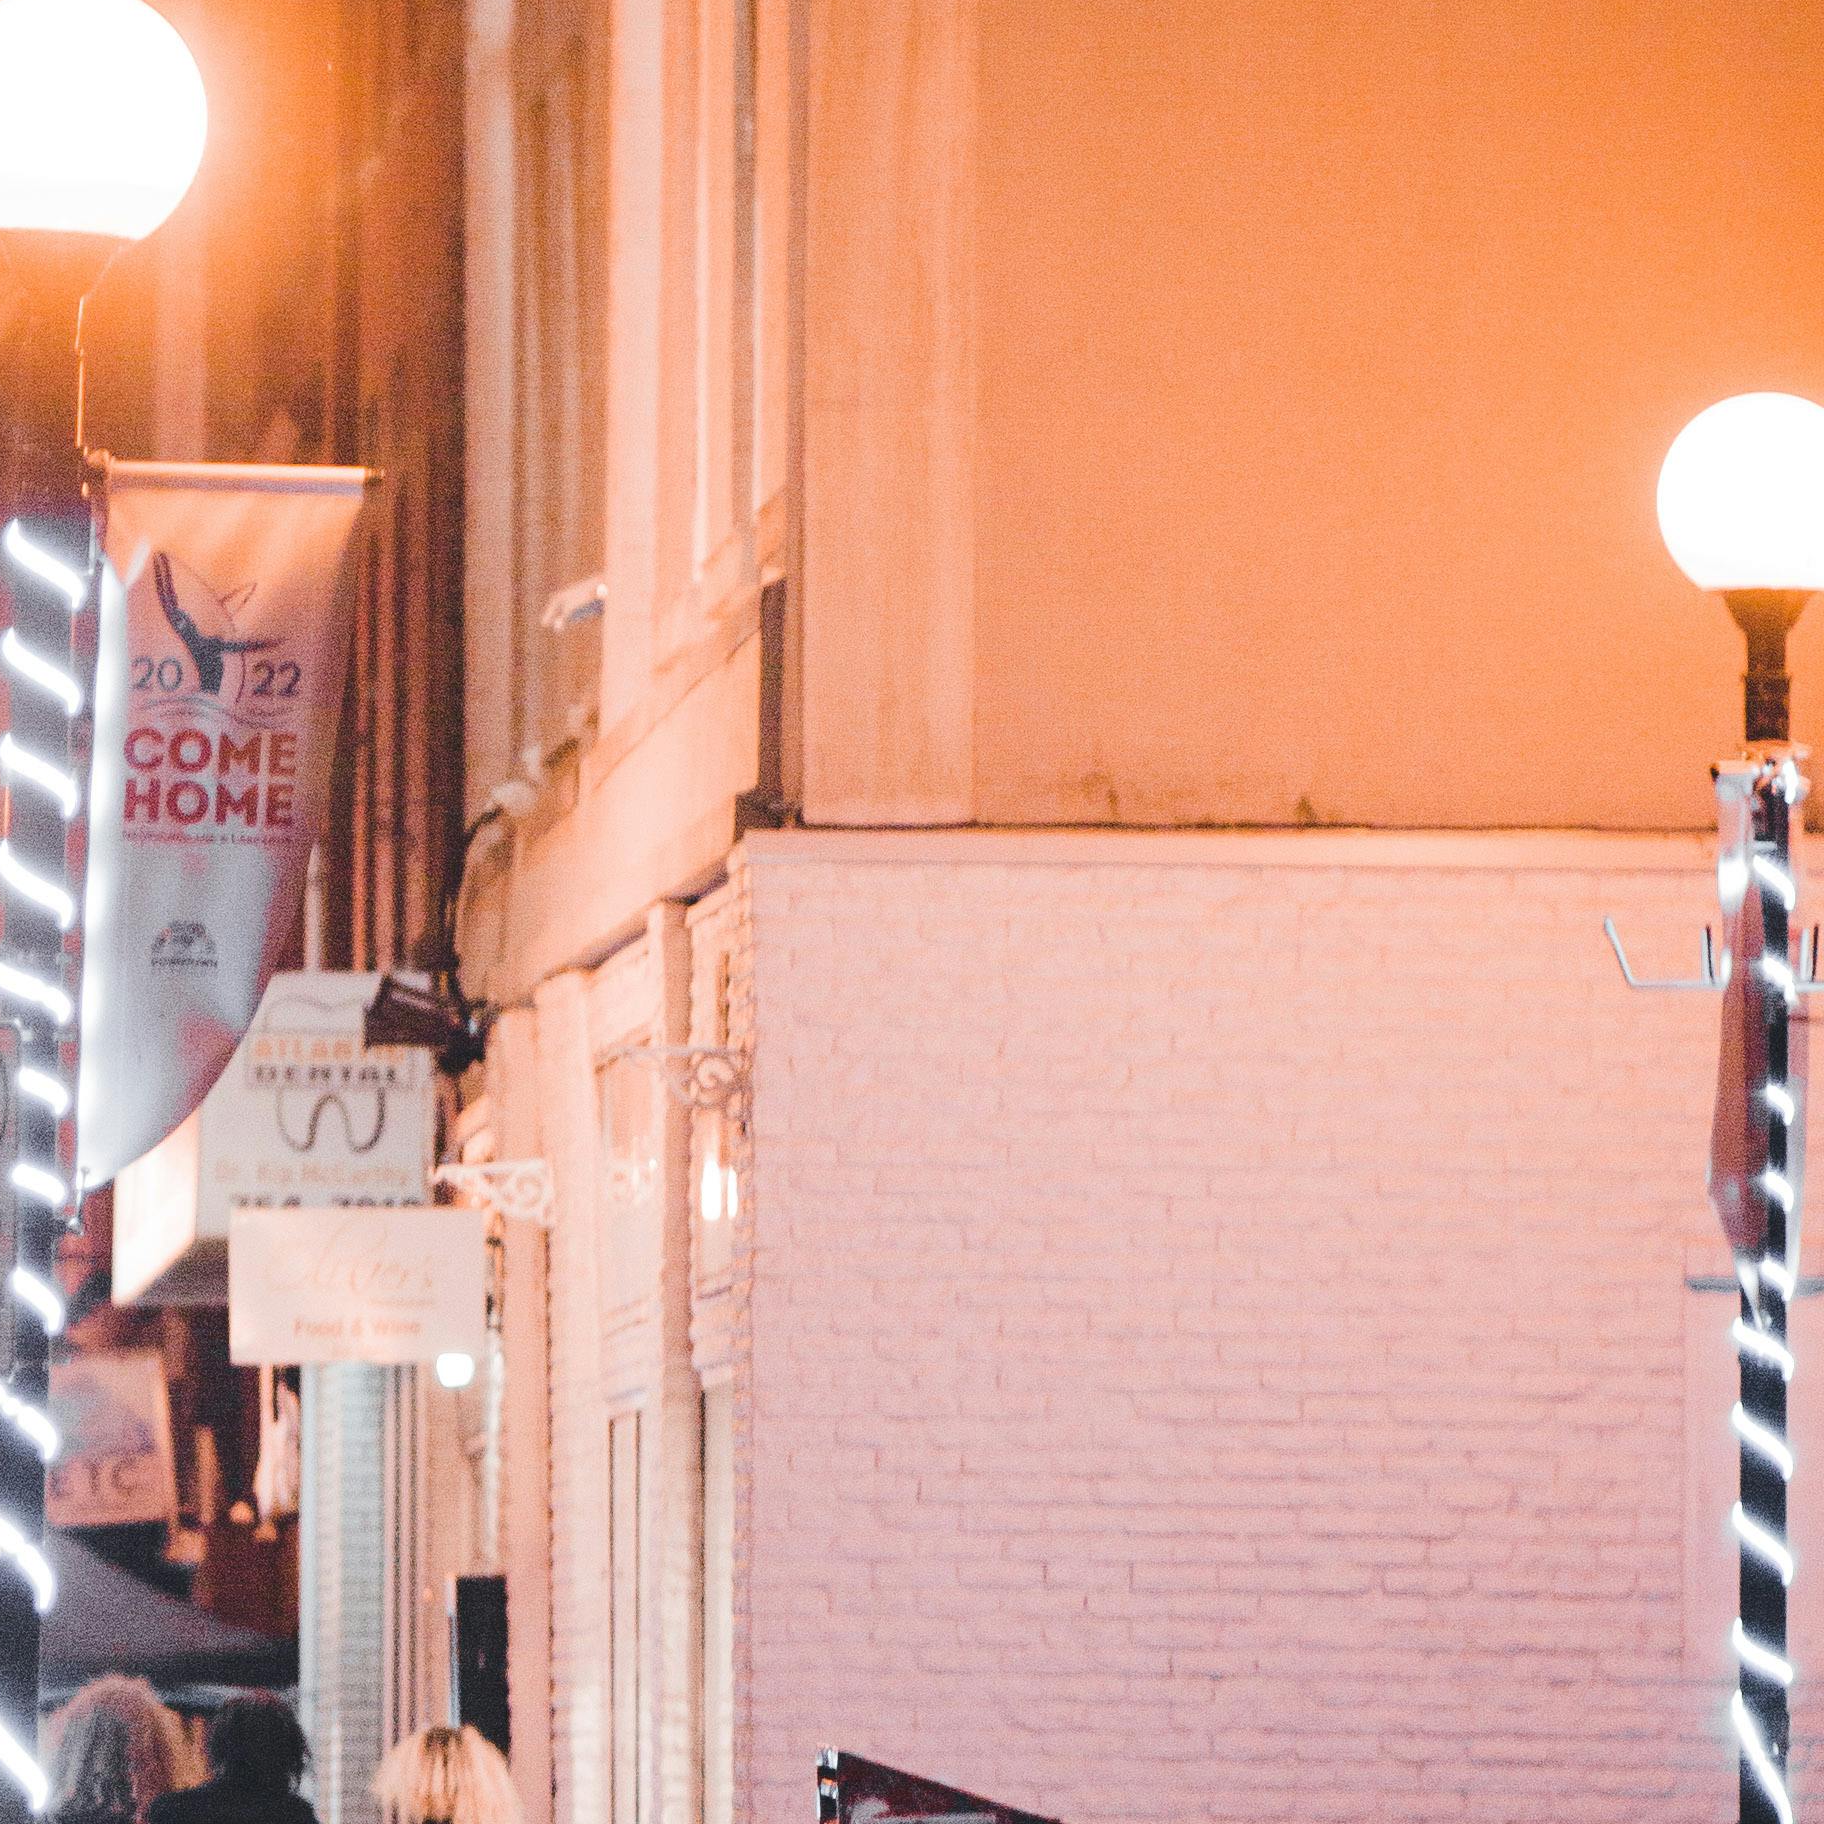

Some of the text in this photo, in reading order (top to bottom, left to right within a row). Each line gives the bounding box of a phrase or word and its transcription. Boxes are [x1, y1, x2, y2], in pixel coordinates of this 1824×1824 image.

[131, 656, 302, 698] 20 22
[124, 728, 297, 776] COME
[123, 777, 295, 827] HOME
